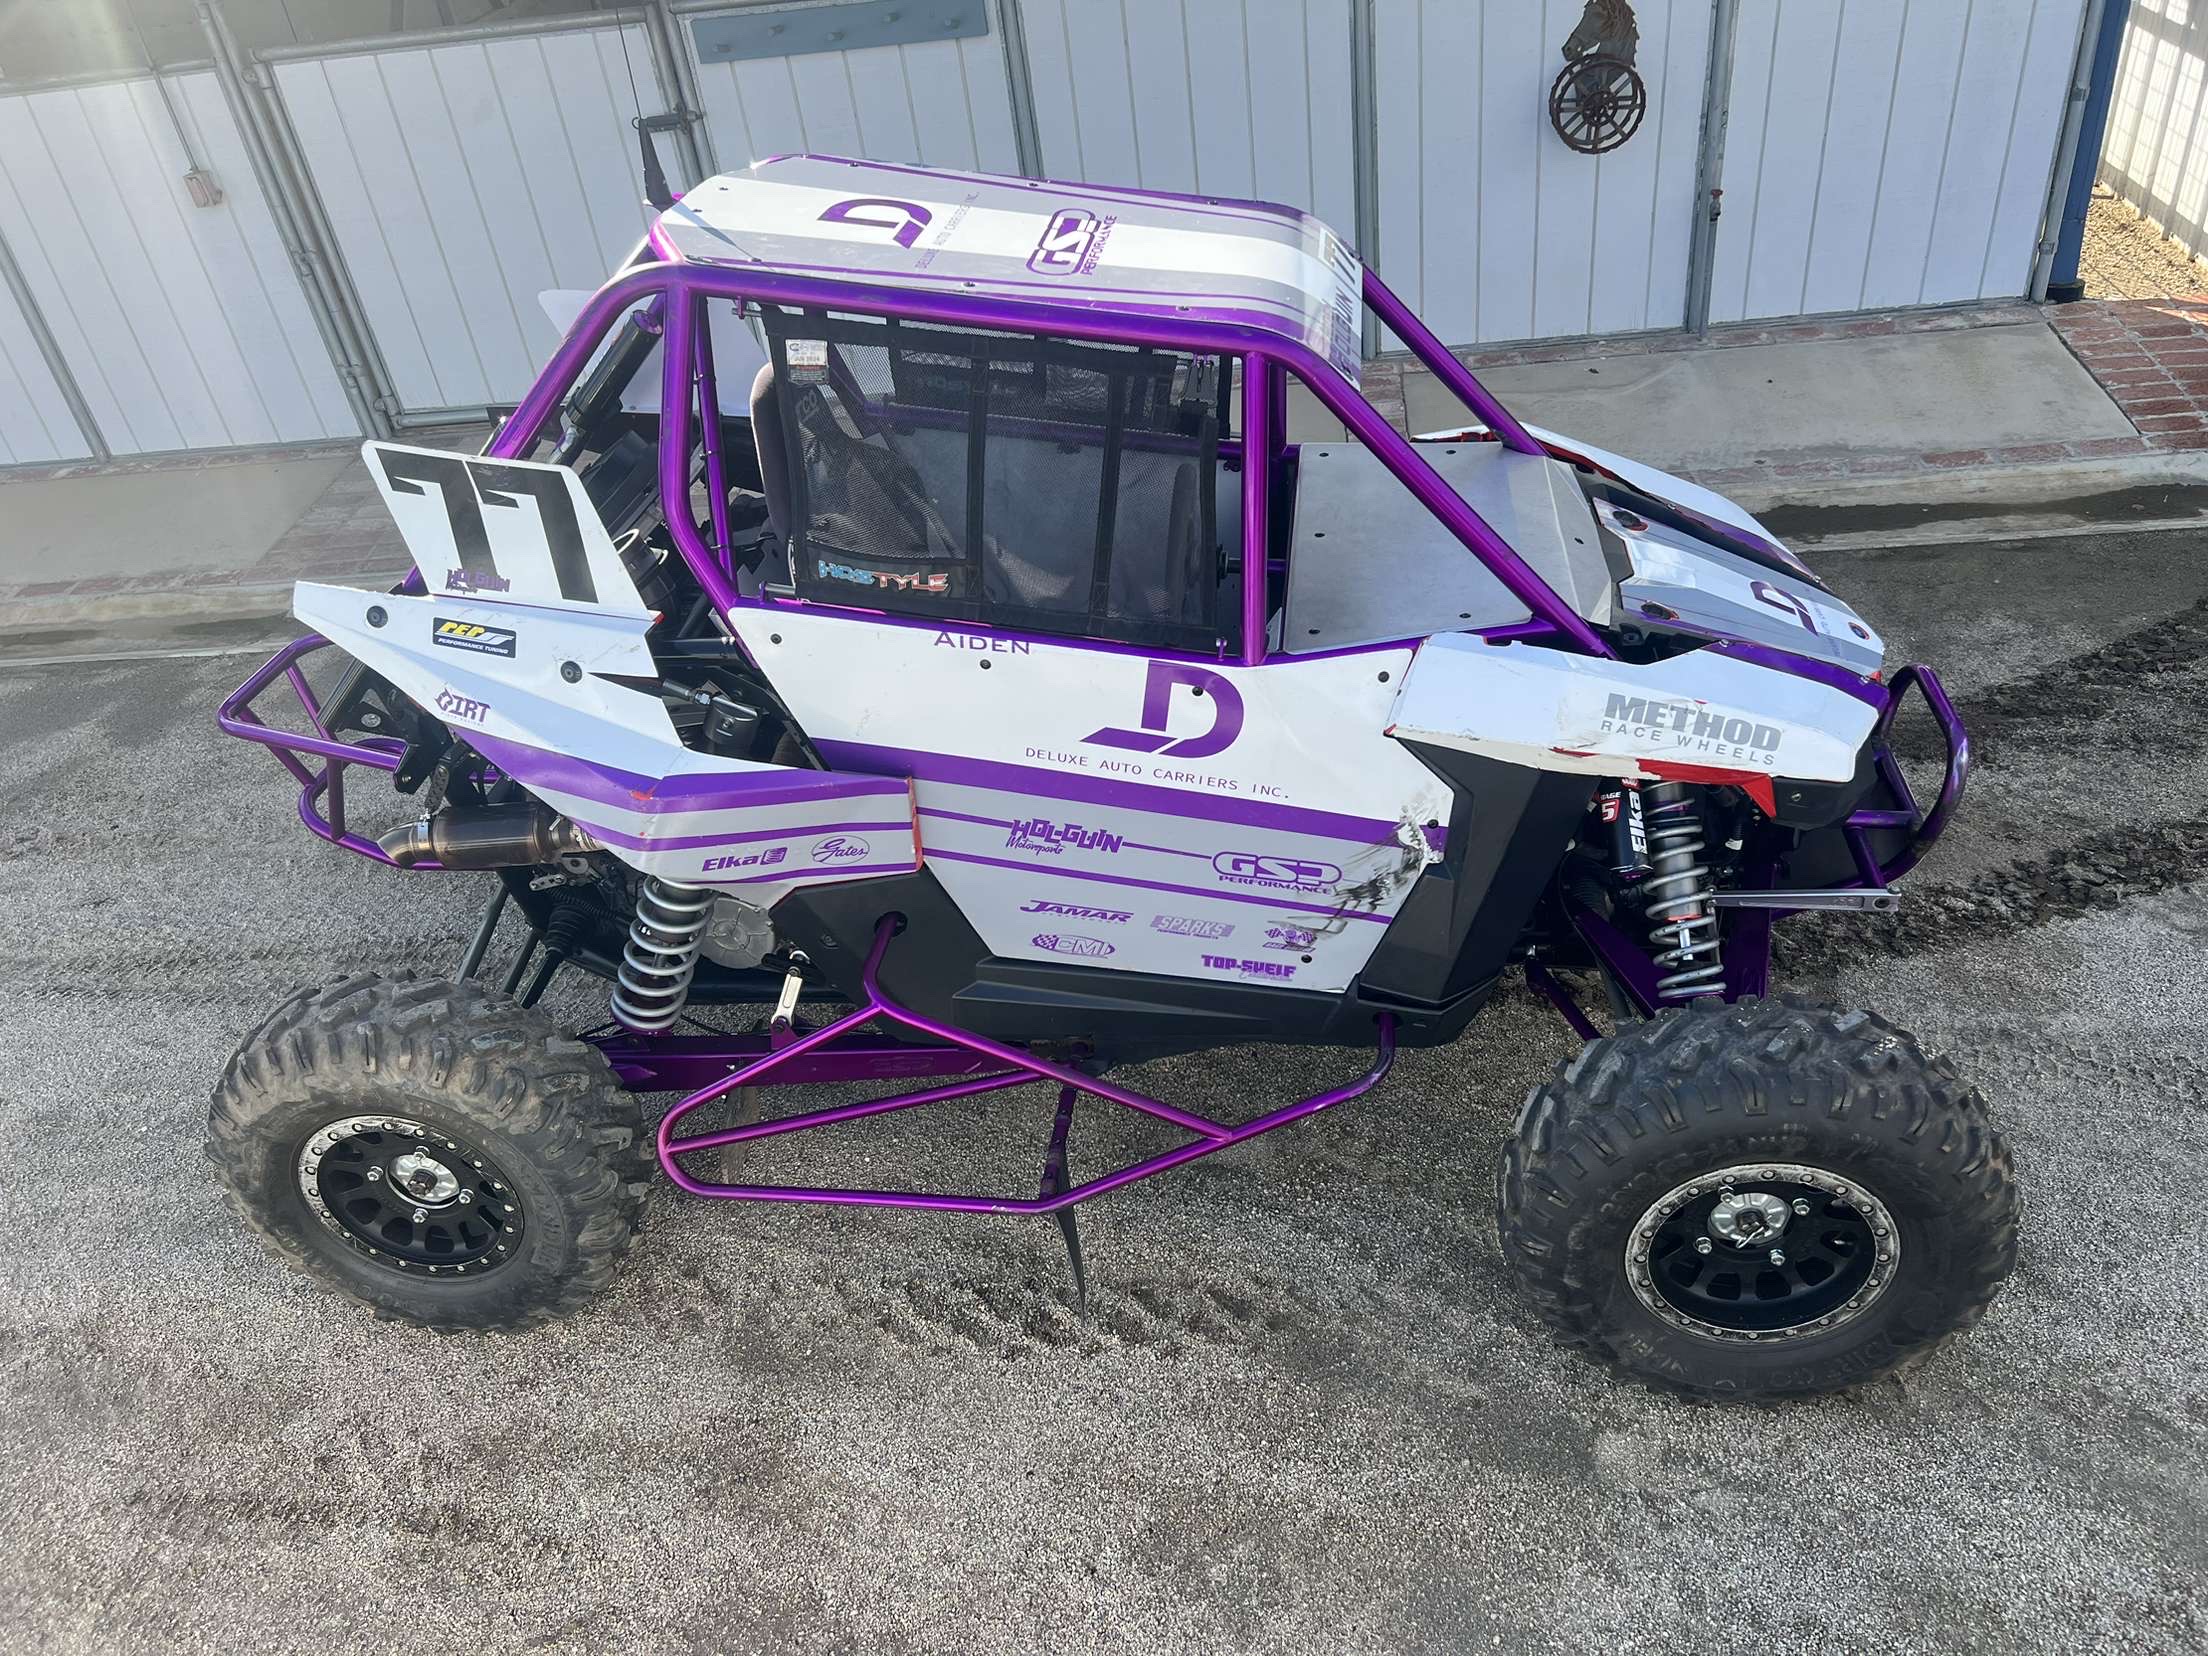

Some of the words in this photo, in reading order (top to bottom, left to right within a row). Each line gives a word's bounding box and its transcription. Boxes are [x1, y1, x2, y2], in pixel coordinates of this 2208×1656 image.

[1080, 214, 1117, 275] PERFORMANCE
[375, 448, 600, 603] 77
[438, 637, 484, 650] PERFORMANCE
[485, 646, 509, 654] TUNING
[934, 631, 1031, 656] AIDEN
[1604, 692, 1783, 752] METHOD
[1601, 720, 1661, 742] RACE
[1677, 735, 1776, 765] WHEELS
[1025, 747, 1088, 767] DELUXE
[1099, 759, 1142, 776] AUTO
[1153, 767, 1238, 791] CARRIERS
[1252, 783, 1289, 799] INC.
[1629, 790, 1648, 854] Elka
[701, 855, 760, 872] Elka
[813, 838, 868, 864] Gates
[1219, 875, 1333, 895] PERFORMANCE
[1020, 899, 1134, 923] JAMAR
[1159, 916, 1226, 935] SPARKS
